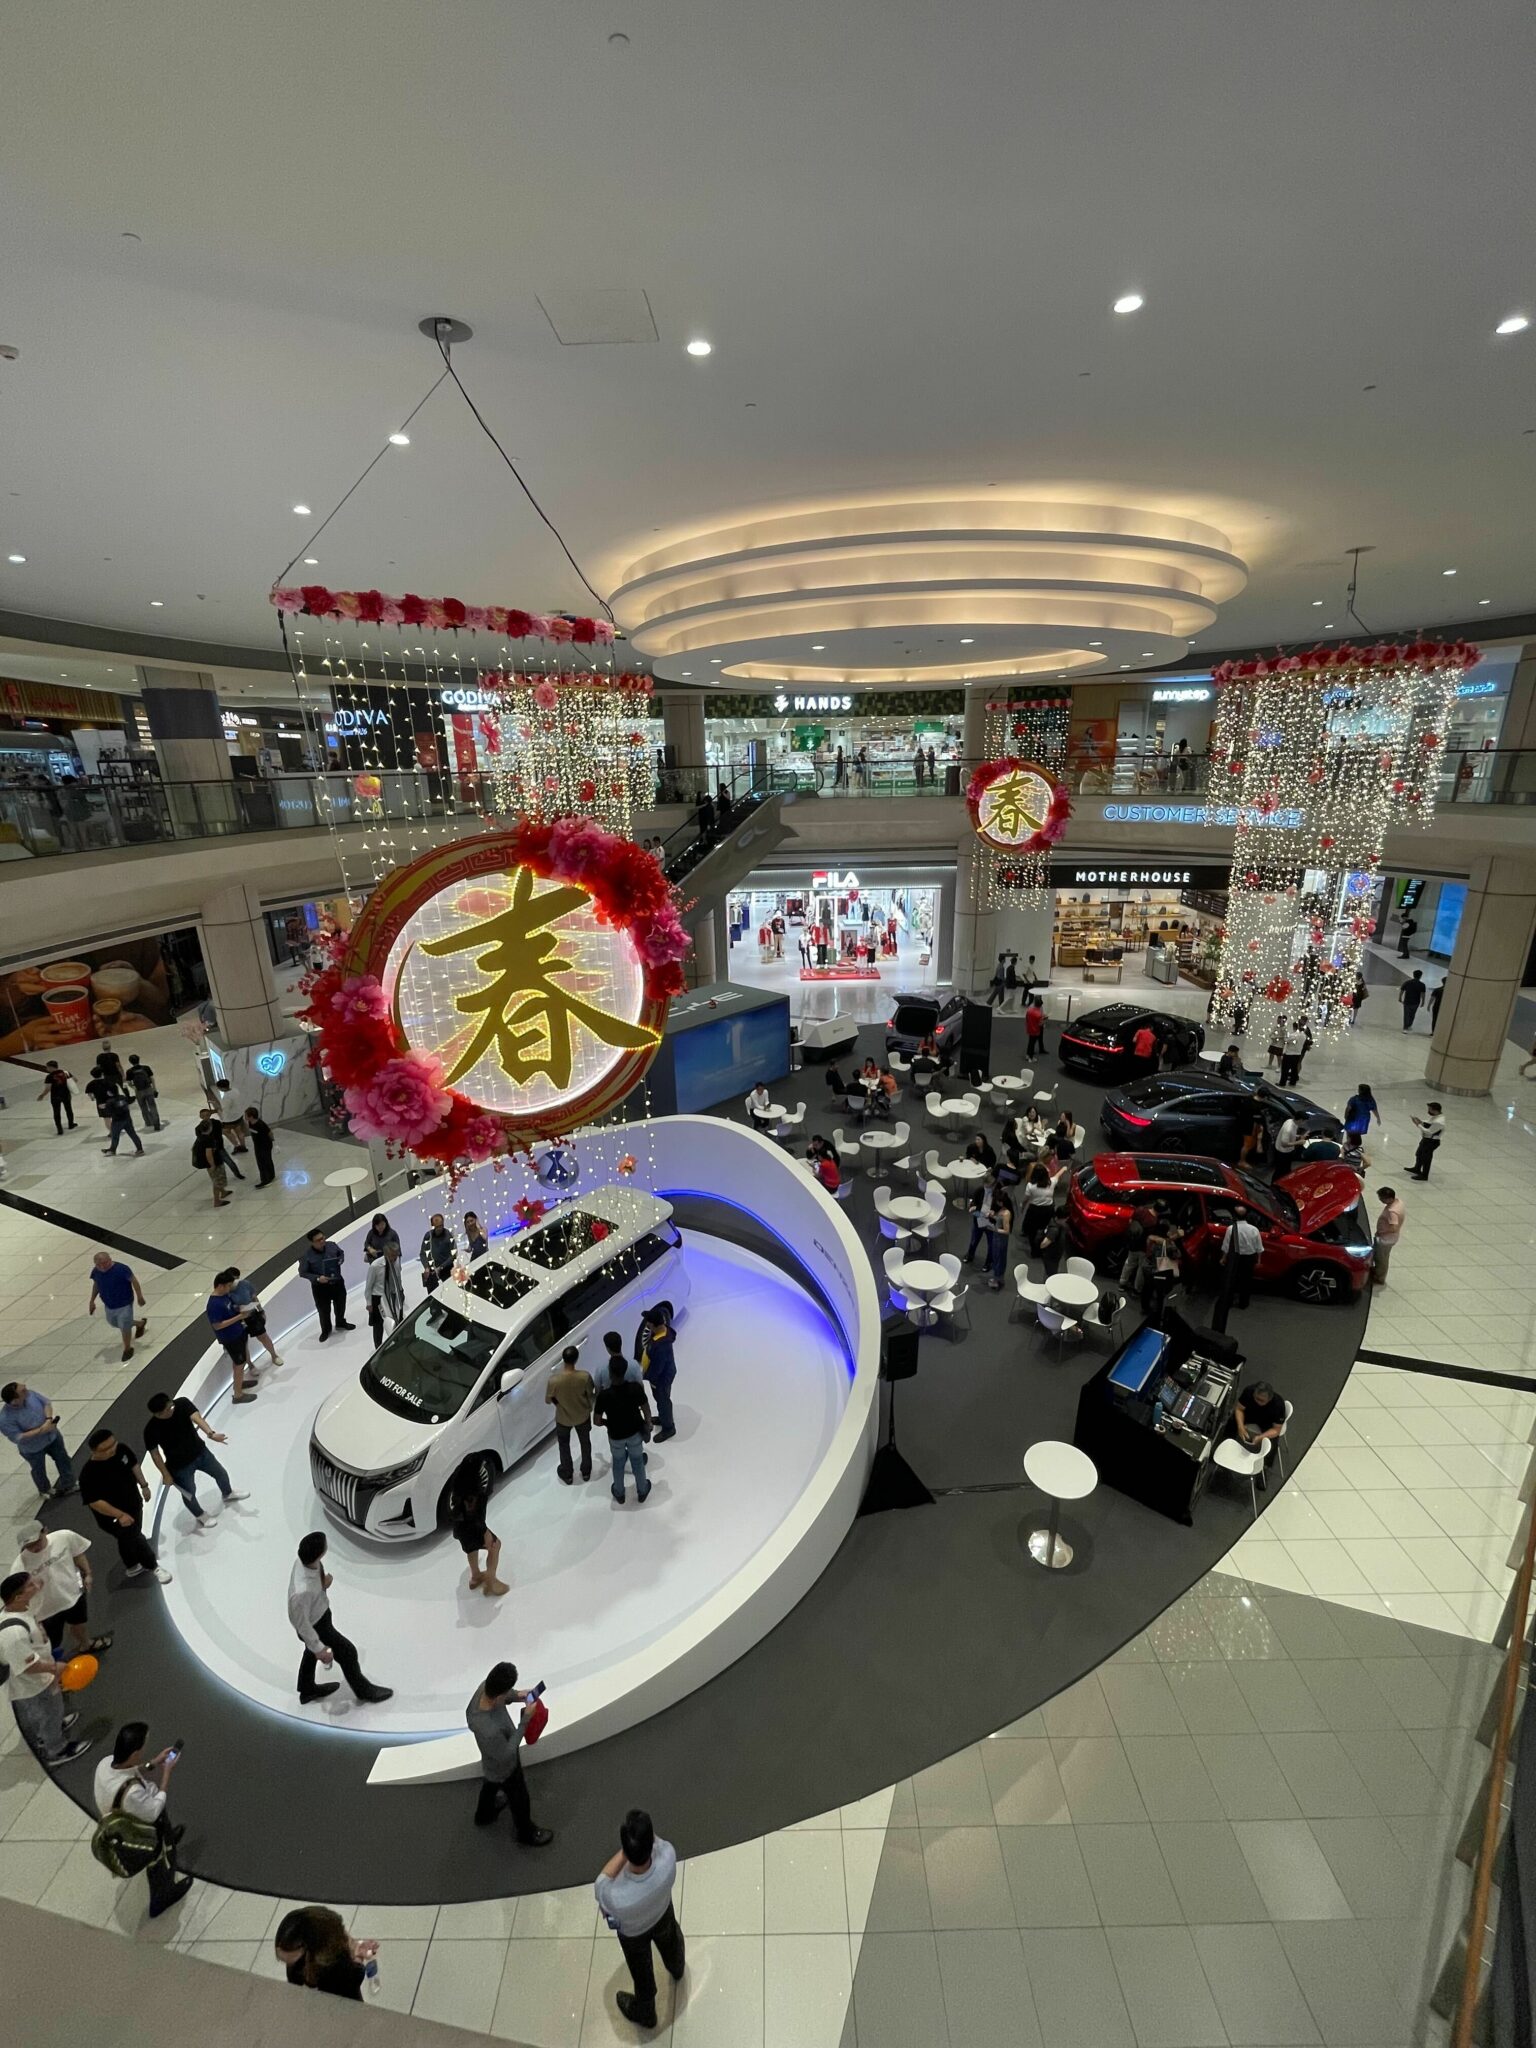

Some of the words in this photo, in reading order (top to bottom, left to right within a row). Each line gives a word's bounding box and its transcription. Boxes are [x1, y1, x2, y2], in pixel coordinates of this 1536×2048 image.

[794, 696, 852, 710] HANDS
[334, 709, 389, 726] ODIVA
[976, 767, 1046, 839] 春
[1103, 805, 1207, 823] CUSTOMER
[1214, 808, 1301, 829] SEVICE
[812, 871, 860, 888] FILA
[1075, 871, 1191, 883] MOTHERHOUSE
[416, 863, 663, 1091] 春
[379, 1376, 395, 1389] NOT
[392, 1384, 407, 1397] FOR
[404, 1392, 423, 1407] SALE
